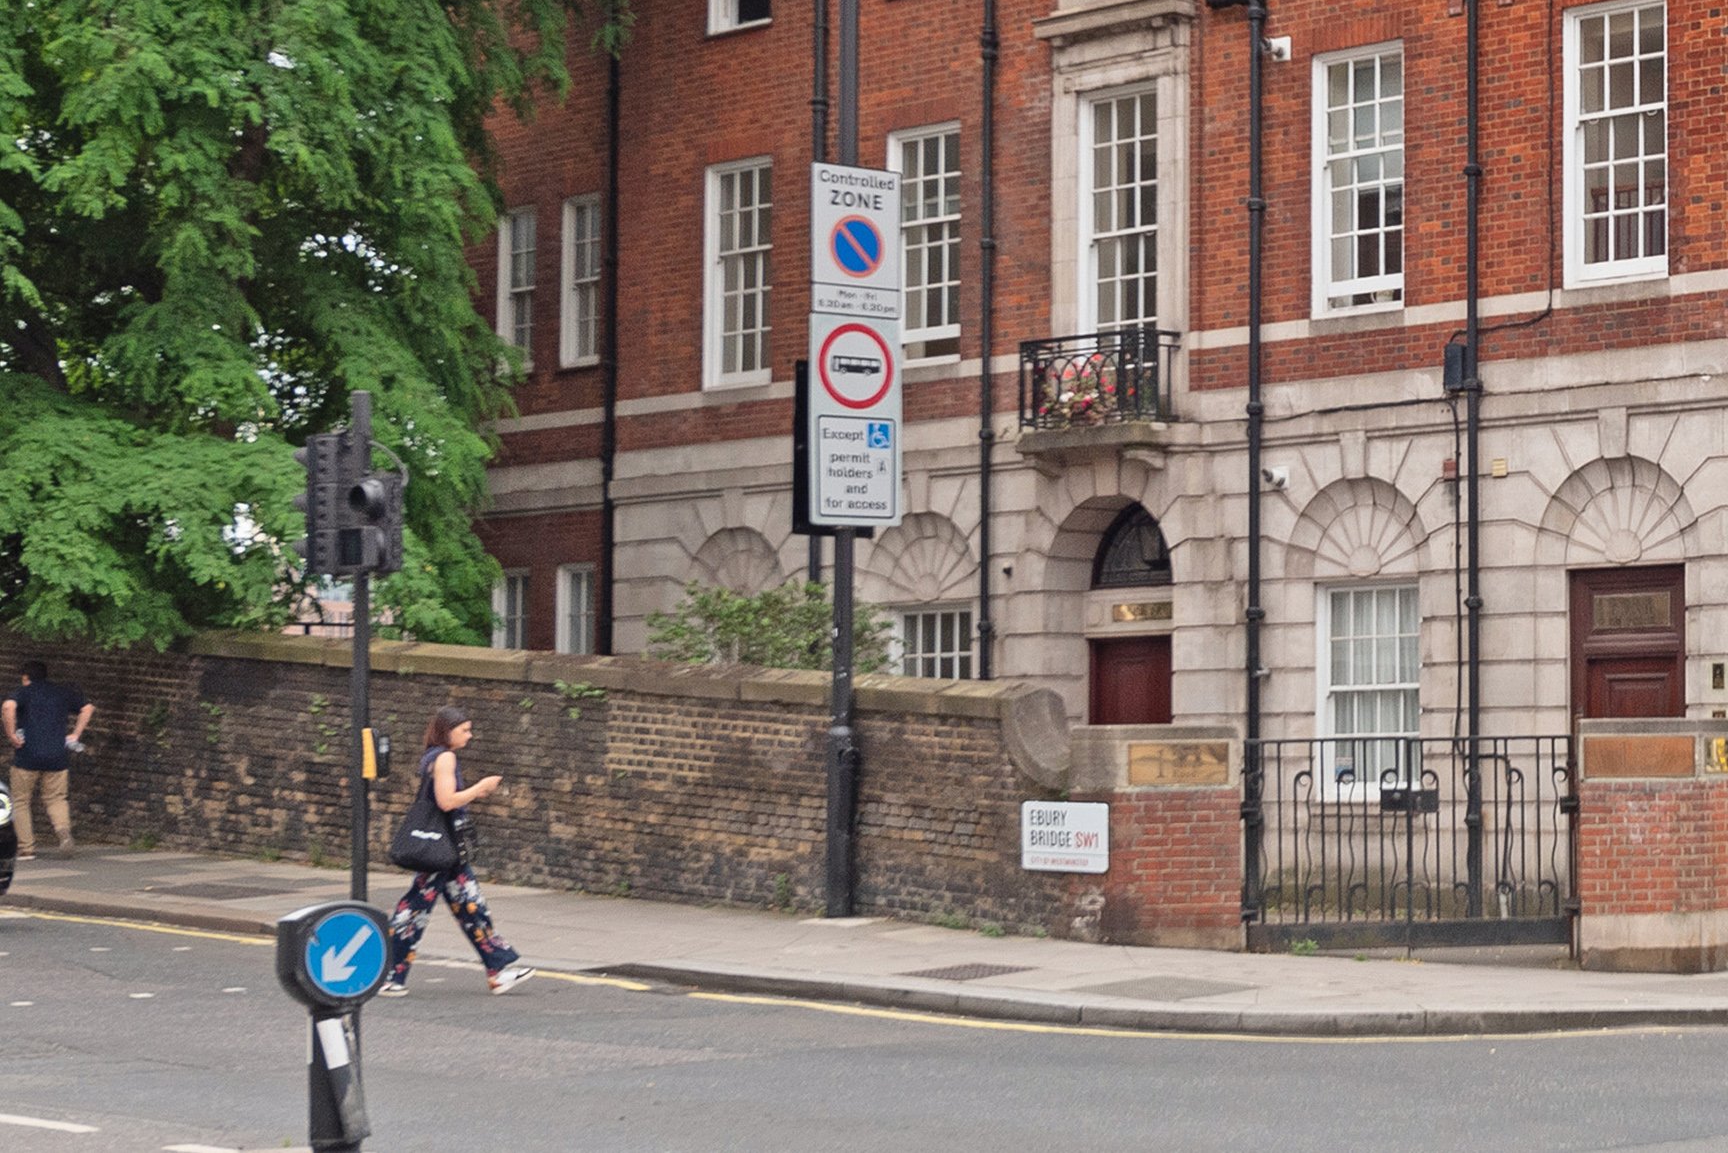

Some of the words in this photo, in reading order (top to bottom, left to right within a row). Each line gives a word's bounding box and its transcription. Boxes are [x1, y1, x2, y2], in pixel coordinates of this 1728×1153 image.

[820, 169, 895, 191] Controlled
[831, 189, 883, 211] ZONE
[823, 427, 864, 441] Except
[830, 452, 871, 464] permit
[828, 467, 873, 479] holders
[846, 483, 868, 495] and
[826, 496, 844, 508] for
[847, 500, 887, 510] access
[1030, 809, 1067, 826] EBURY
[1030, 830, 1072, 847] BRIDGE
[1075, 832, 1099, 849] SW1
